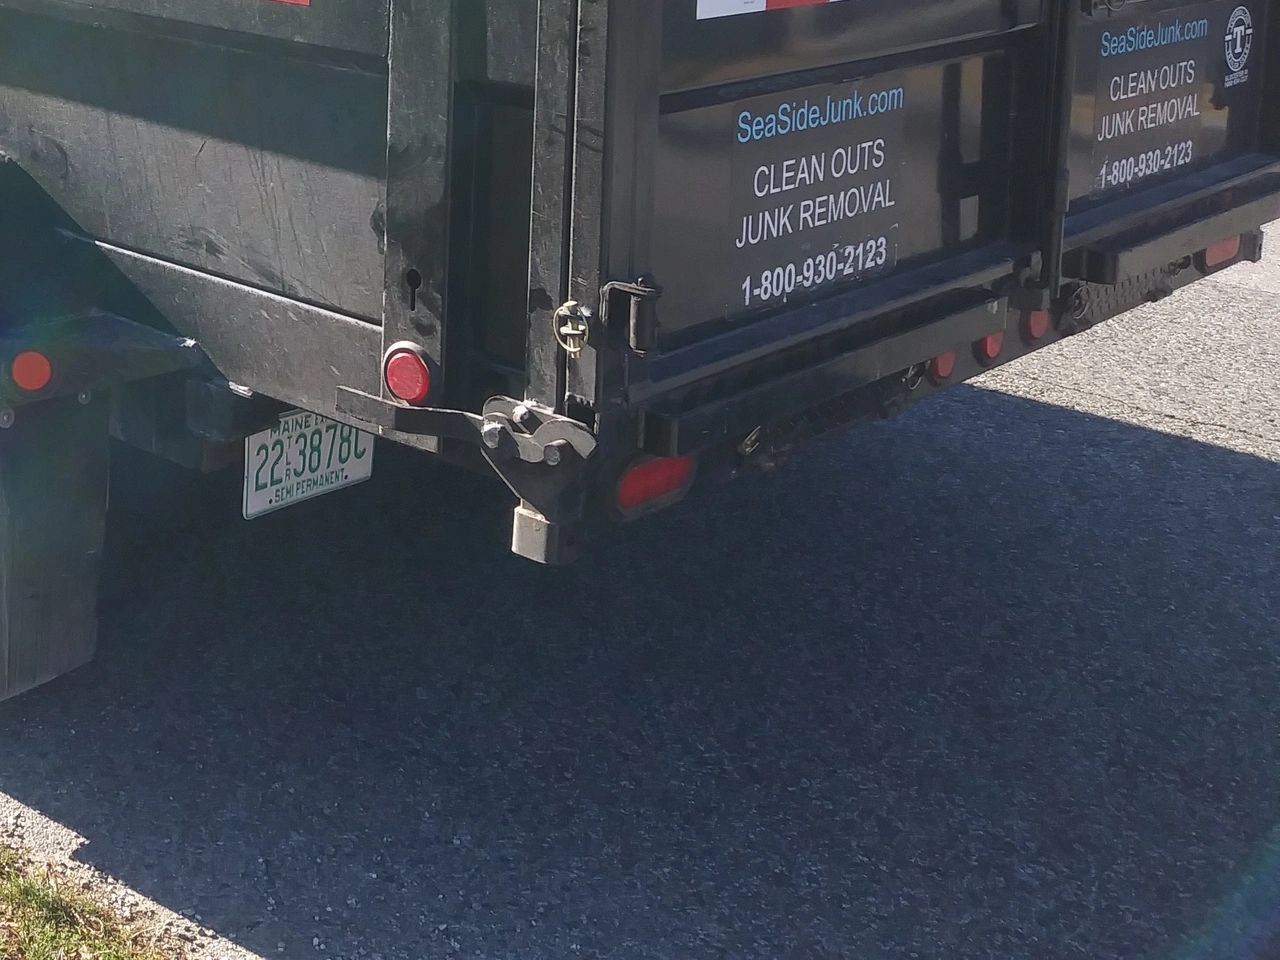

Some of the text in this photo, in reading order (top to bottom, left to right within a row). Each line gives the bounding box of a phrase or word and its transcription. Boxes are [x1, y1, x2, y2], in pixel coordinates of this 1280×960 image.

[1101, 18, 1208, 57] SeaSideJunk.com
[1109, 69, 1157, 102] CLEAN
[1160, 59, 1196, 91] OUTS
[737, 87, 904, 143] SeaSideJunk.com
[1097, 93, 1201, 142] JUNK REMOVAL
[754, 138, 885, 197] CLEAN OUTS
[1099, 140, 1193, 188] 1-800-930-2123
[735, 179, 896, 248] JUNK REMOVAL
[741, 236, 887, 306] 1-800-930-2123
[270, 414, 312, 438] MAINE
[274, 468, 345, 503] SEMI PERMANENT
